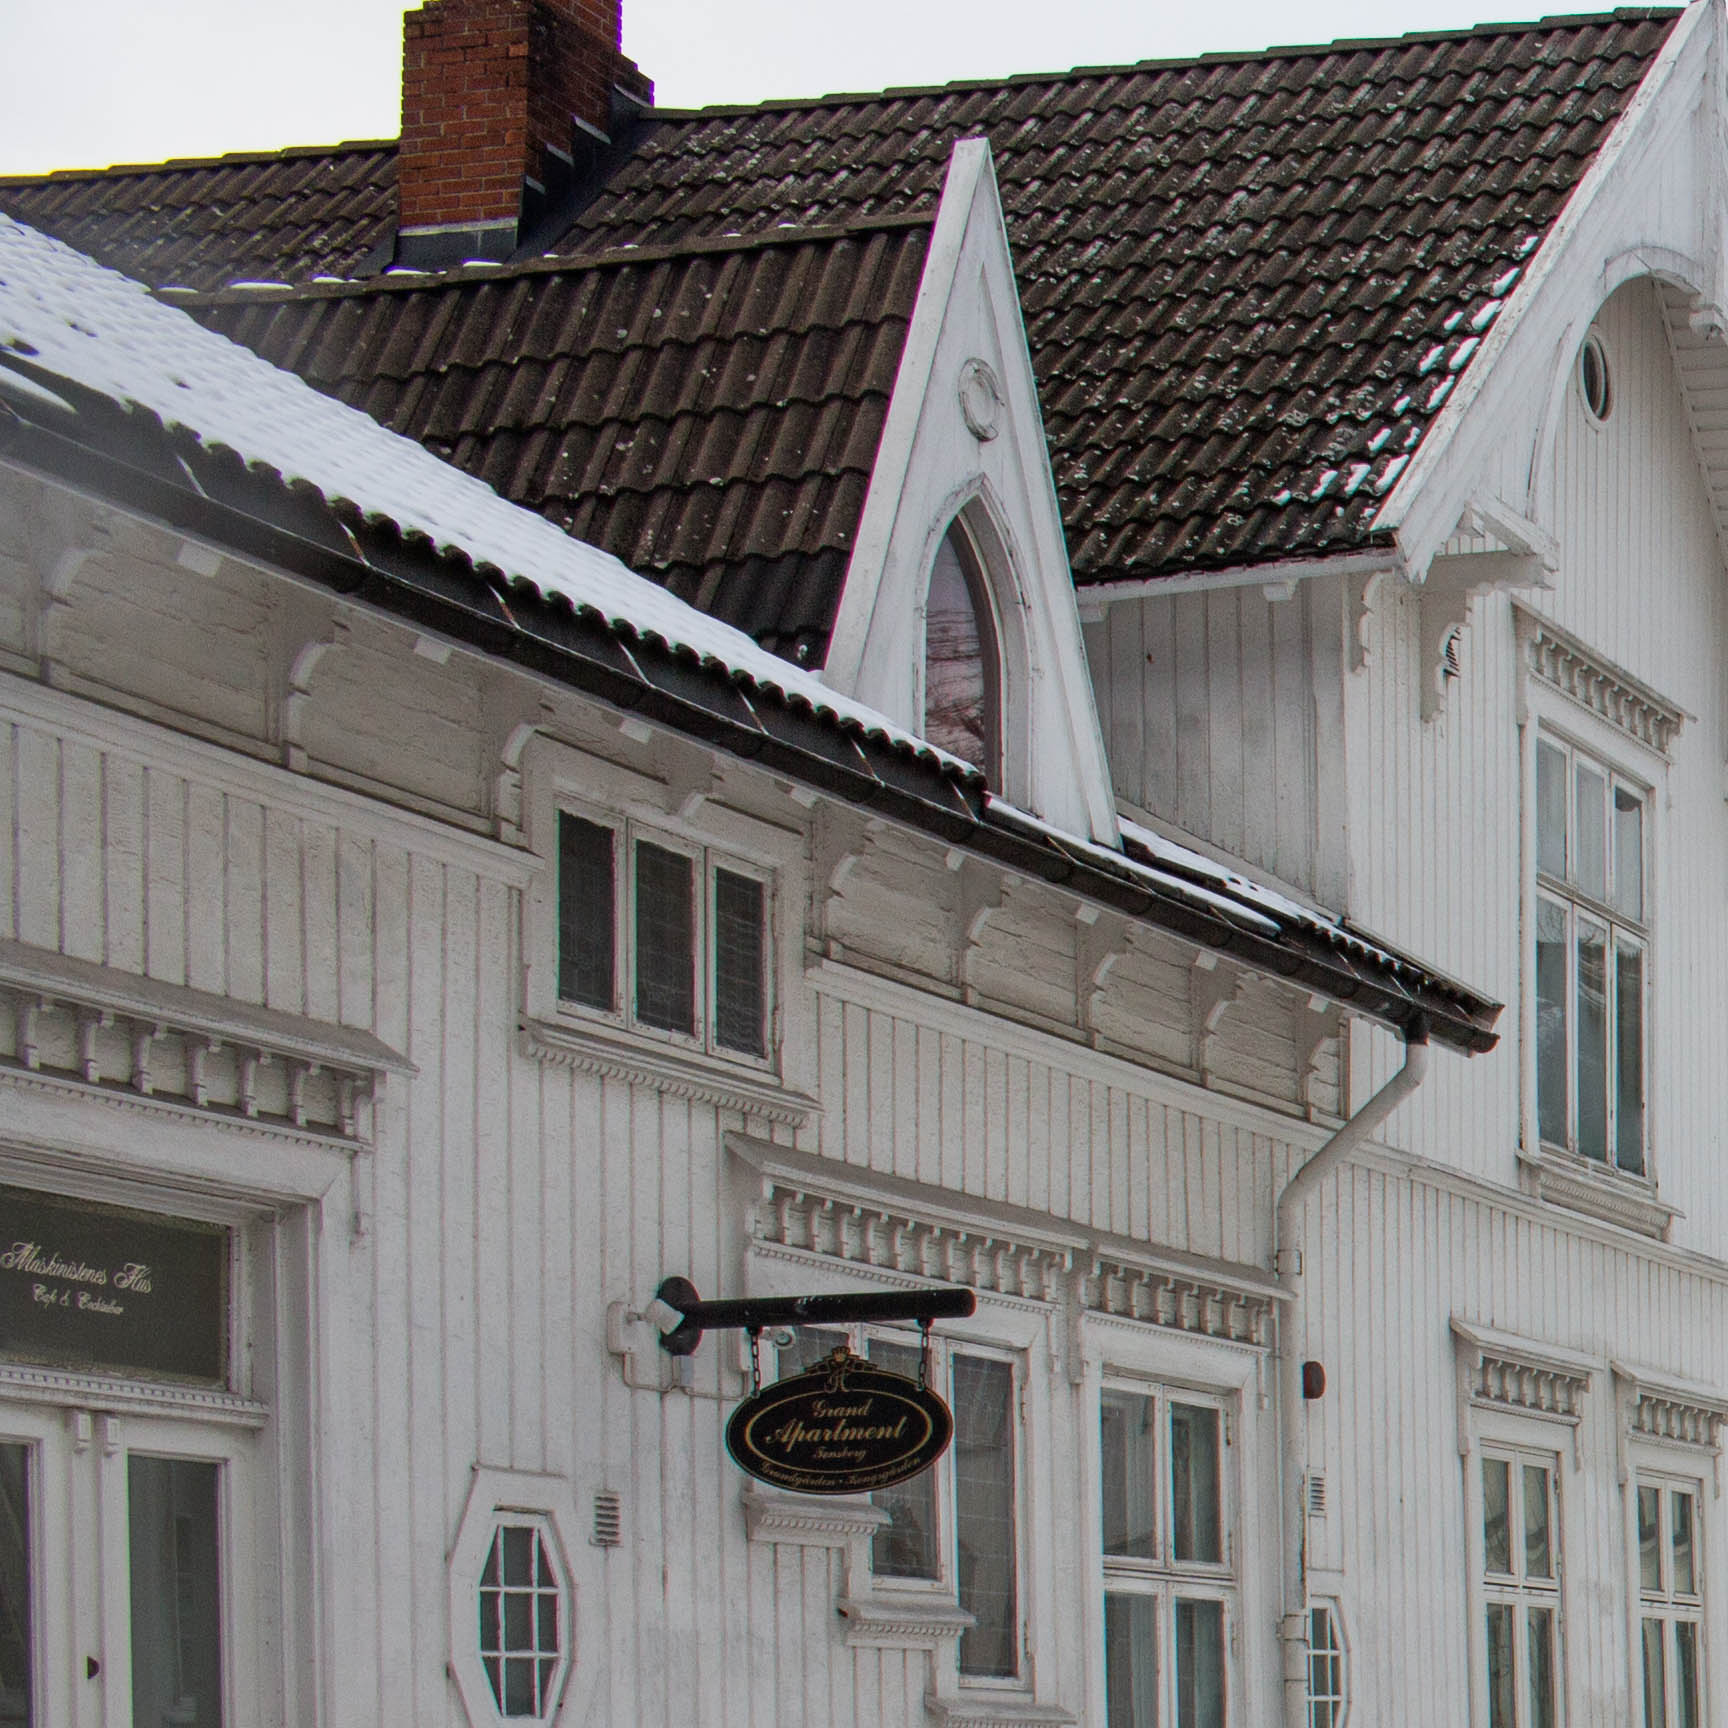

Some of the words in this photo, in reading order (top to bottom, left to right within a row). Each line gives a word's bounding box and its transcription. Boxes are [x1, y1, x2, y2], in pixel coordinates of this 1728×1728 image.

[113, 1262, 152, 1293] Hus
[812, 1398, 873, 1418] Grand
[765, 1416, 908, 1453] Apartment
